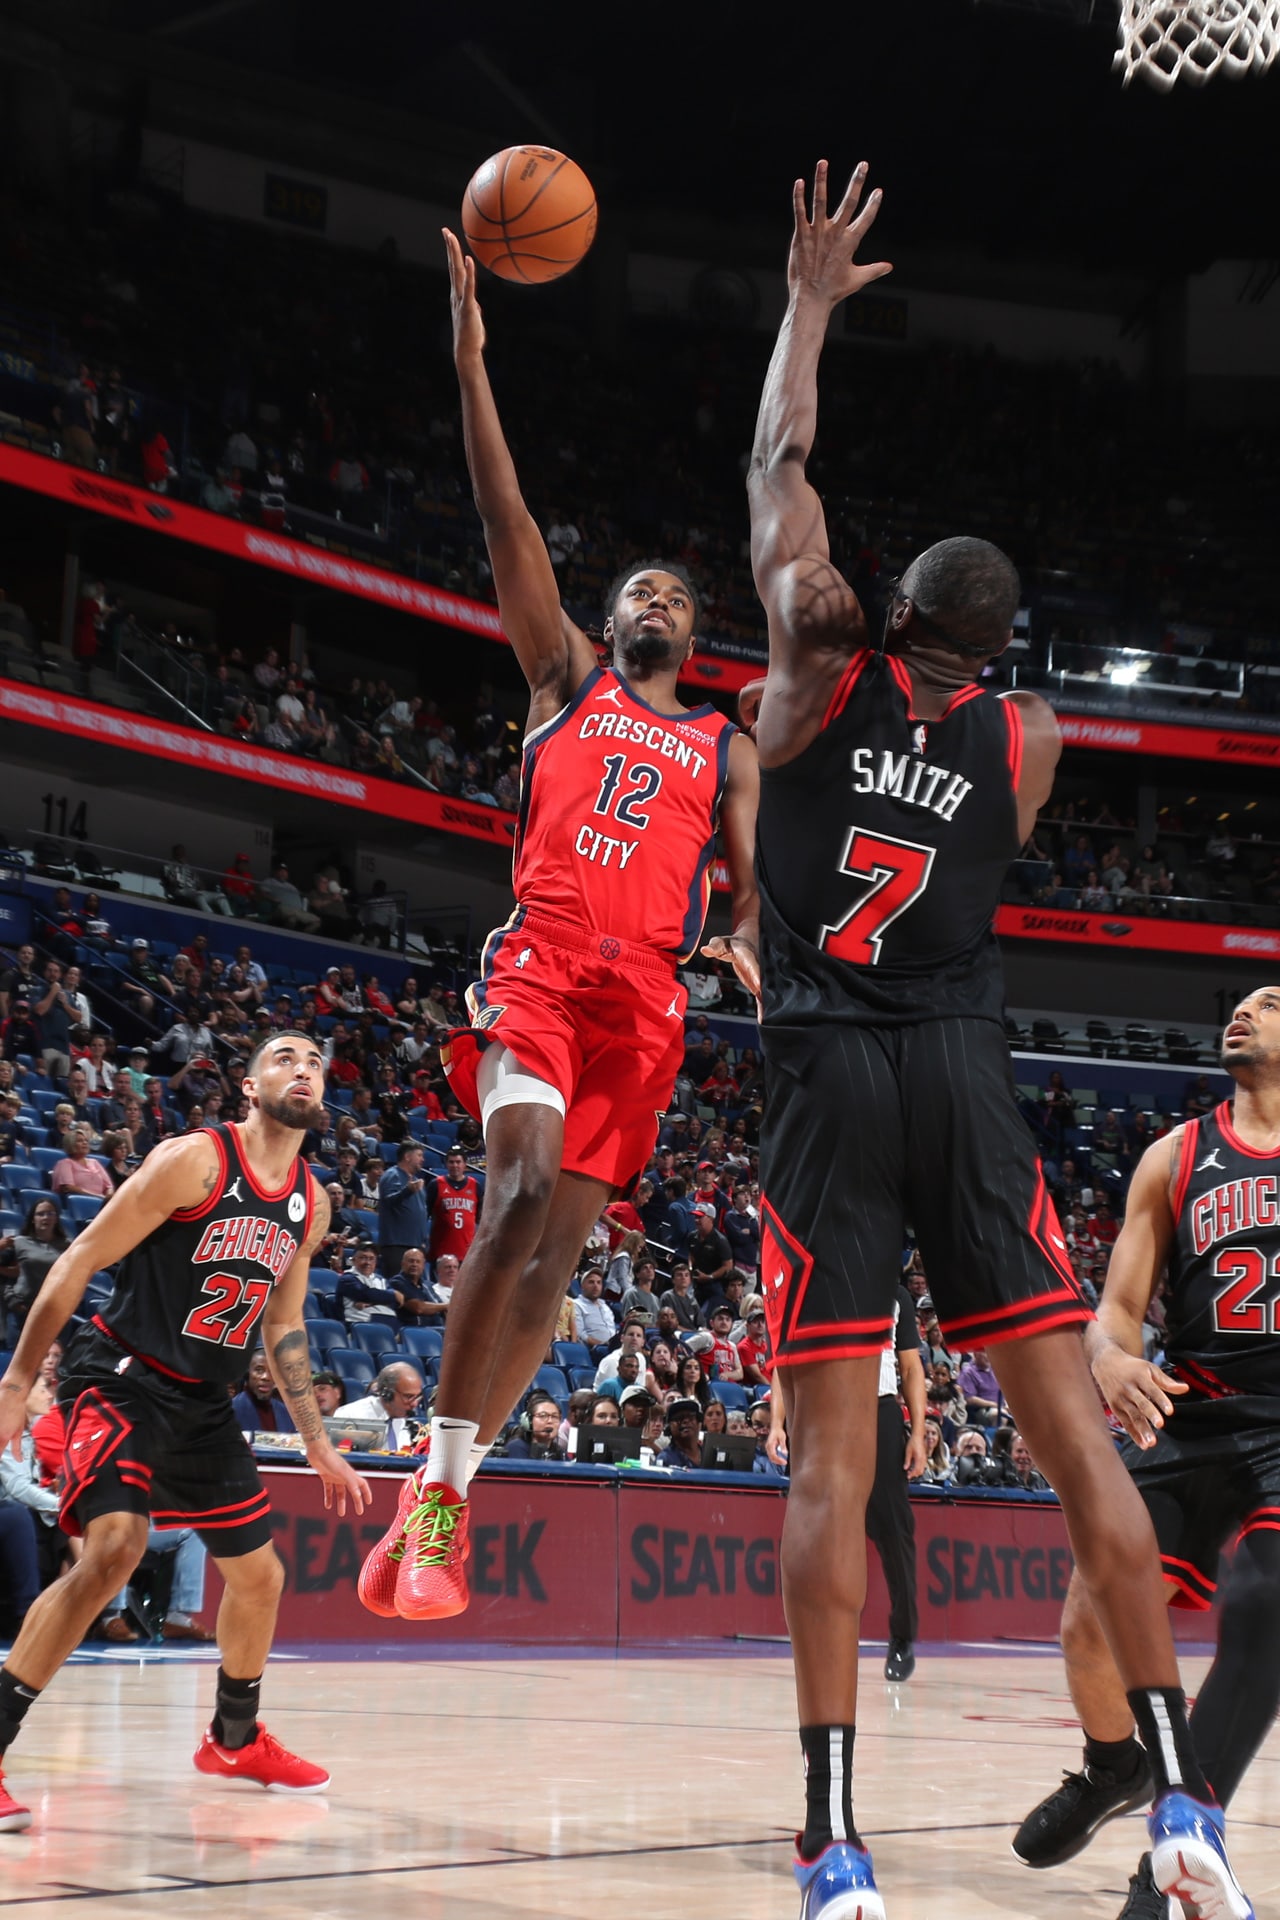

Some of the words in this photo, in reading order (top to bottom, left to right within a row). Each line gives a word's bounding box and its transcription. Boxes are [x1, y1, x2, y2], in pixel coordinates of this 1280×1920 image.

[578, 713, 707, 779] CRESCENT
[42, 793, 88, 841] 114
[593, 753, 662, 830] 12
[852, 748, 973, 821] SMITH
[575, 825, 640, 869] CITY
[819, 826, 937, 965] 7
[191, 1216, 297, 1286] CHICAGO
[454, 1212, 463, 1229] 5
[1192, 1176, 1280, 1256] CHIC
[181, 1271, 273, 1349] 27
[631, 1523, 775, 1604] SEATG
[927, 1536, 1075, 1608] SEATGE
